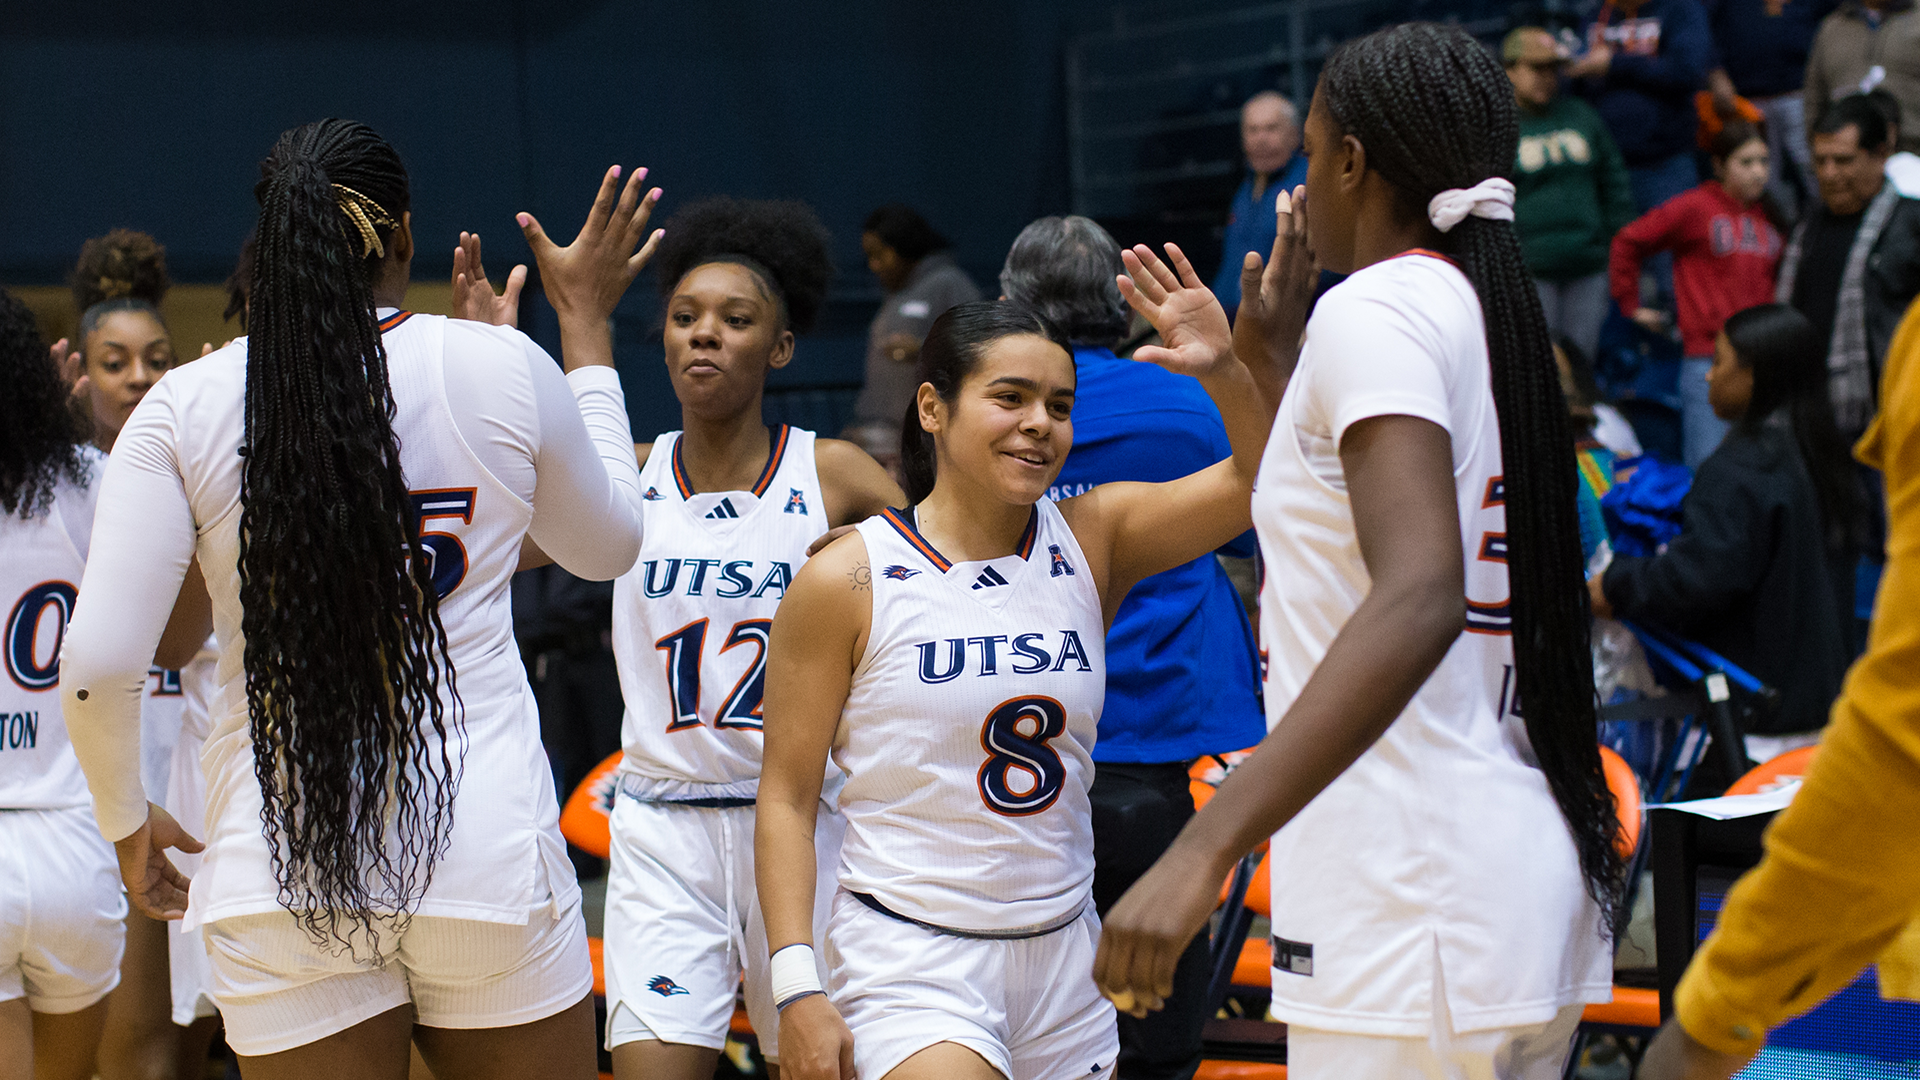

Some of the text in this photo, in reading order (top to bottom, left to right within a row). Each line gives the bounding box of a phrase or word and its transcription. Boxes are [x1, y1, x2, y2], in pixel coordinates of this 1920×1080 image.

[643, 558, 793, 599] UTSA
[2, 578, 79, 693] 0
[655, 616, 772, 734] 12
[914, 629, 1093, 684] UTSA
[0, 711, 38, 750] TON
[977, 694, 1067, 817] 8
